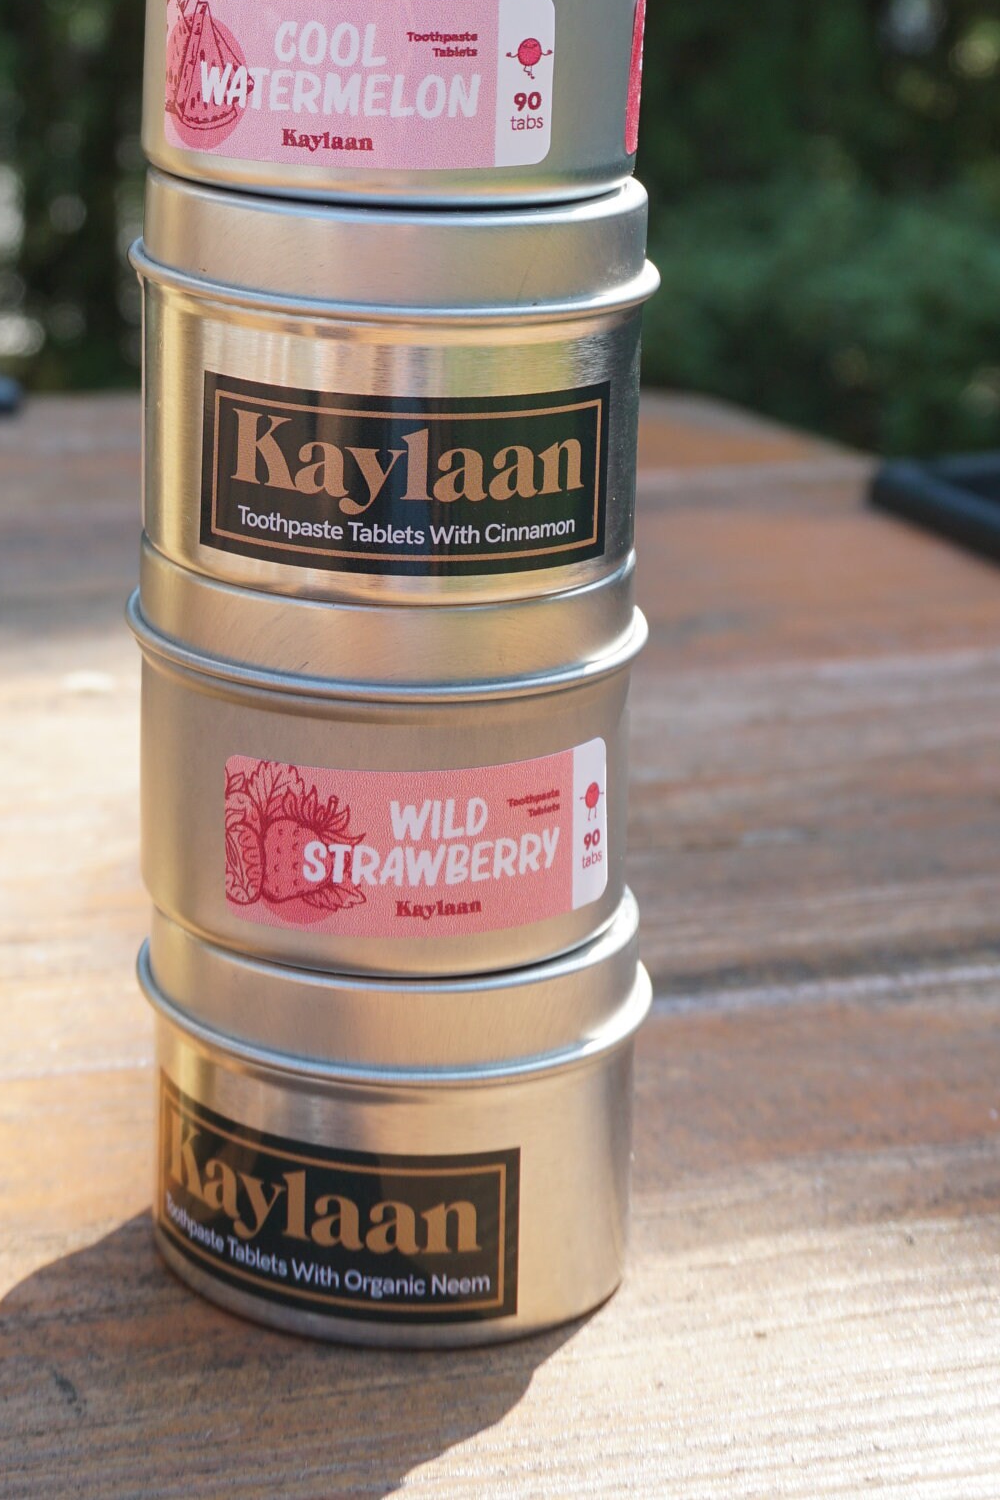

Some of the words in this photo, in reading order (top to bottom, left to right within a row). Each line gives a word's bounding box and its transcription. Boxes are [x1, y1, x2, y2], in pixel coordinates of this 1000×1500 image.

[274, 20, 387, 68] COOL
[407, 31, 478, 45] Toothpaste
[432, 46, 478, 58] Tablets
[200, 61, 482, 120] WATERMELON
[513, 91, 542, 112] 90
[510, 113, 544, 131] tabs
[281, 128, 374, 152] Kaylaan
[230, 407, 584, 515] Kaylaan
[238, 505, 343, 540] Toothpaste
[348, 521, 425, 545] Tablets
[429, 525, 481, 545] With
[485, 518, 575, 542] Cinnamon
[507, 787, 560, 808] Toothpaste
[389, 798, 488, 841] WILD
[529, 803, 560, 818] Tablets
[583, 828, 600, 850] 90
[303, 826, 560, 887] STRAWBERRY
[581, 850, 602, 869] tabs
[395, 899, 482, 920] Kaylaan
[169, 1109, 482, 1255] Kaylaan
[227, 1236, 288, 1276] Tablets
[291, 1258, 340, 1290] With
[345, 1270, 425, 1298] Organic
[431, 1273, 490, 1296] Neem
